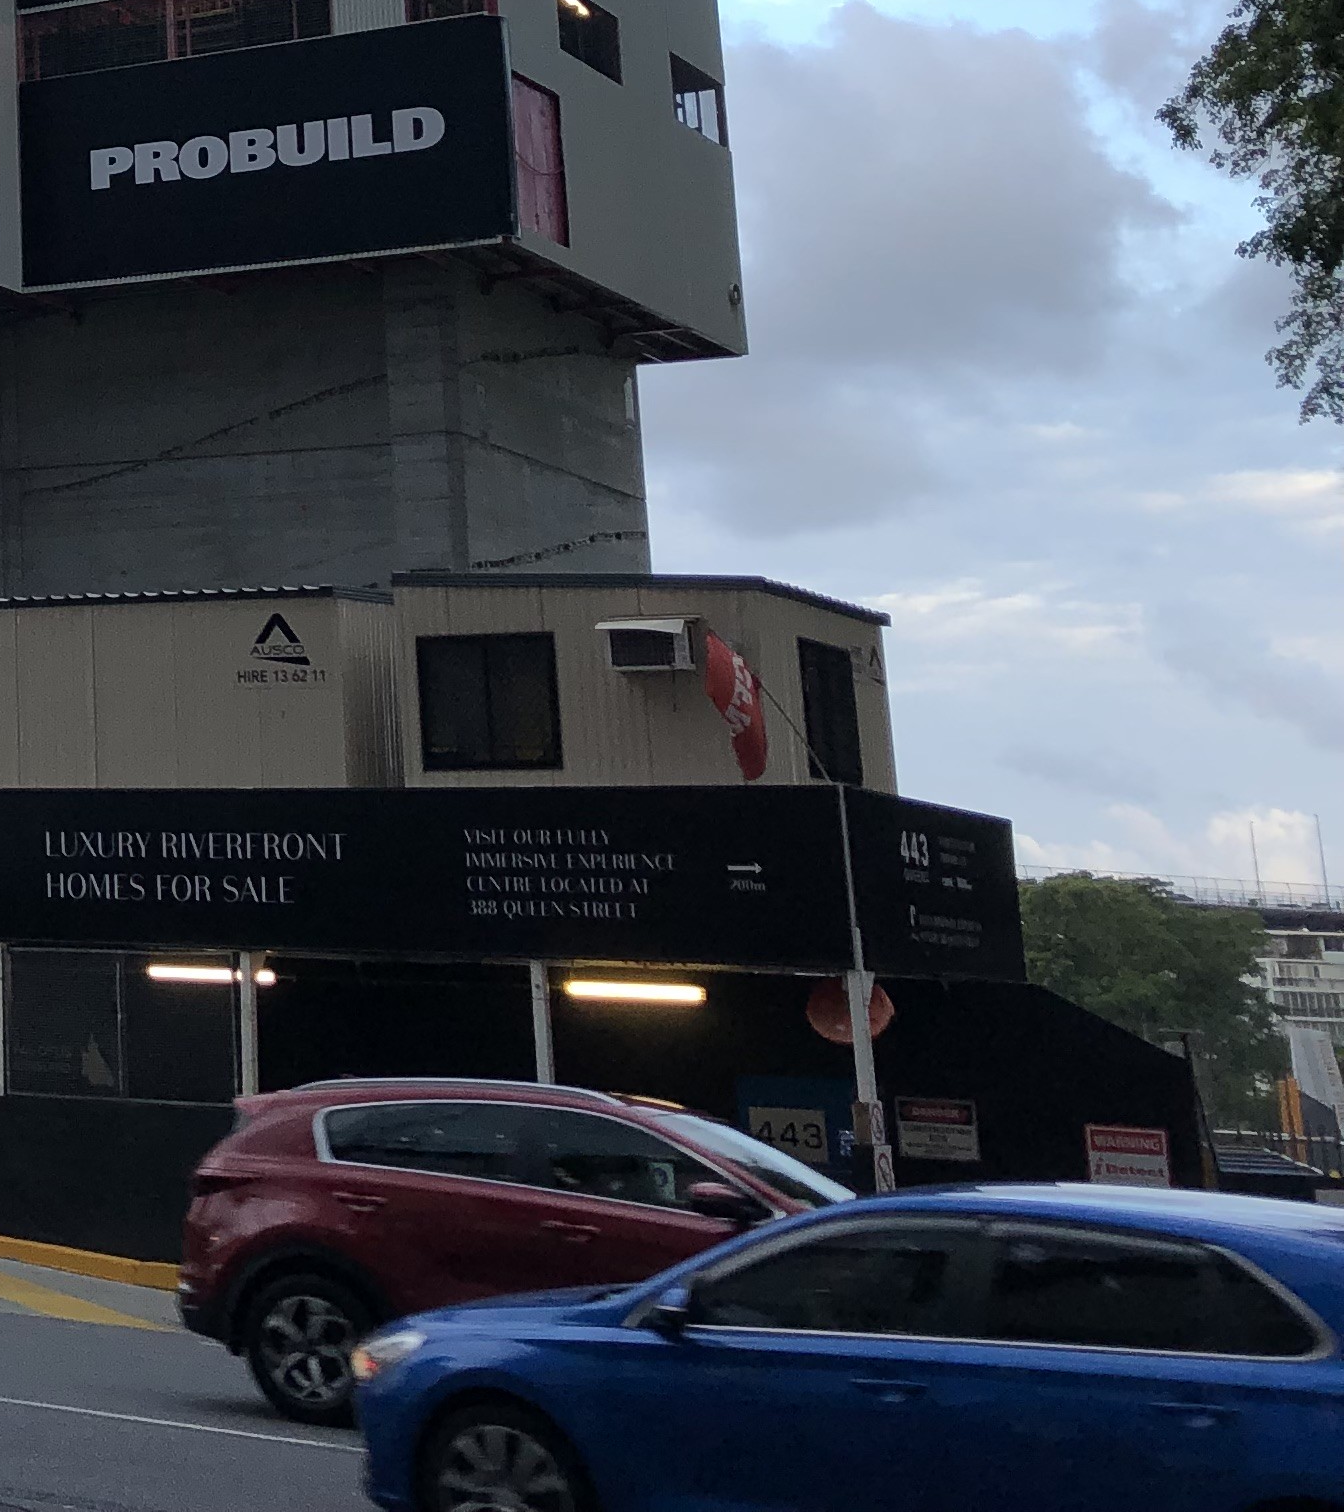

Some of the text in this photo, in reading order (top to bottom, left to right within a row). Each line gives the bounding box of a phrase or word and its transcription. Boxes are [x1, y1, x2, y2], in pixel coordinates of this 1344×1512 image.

[90, 107, 445, 190] PROBUILD
[250, 644, 305, 656] AUSCO
[237, 669, 326, 683] HIRE 13 62 11
[45, 831, 348, 860] LUXURY RIVERFRONT
[463, 829, 507, 845] VISIT
[513, 829, 551, 845] OUR
[900, 830, 929, 867] 443
[465, 852, 677, 871] IMMERSIVE EXPERIENCE
[46, 872, 295, 903] HOMES FOR SALE
[466, 875, 650, 895] CENTRE LOCATED AT
[468, 899, 639, 920] 388 QUEEN STREET
[757, 1120, 823, 1149] 443
[1094, 1134, 1160, 1151] WARNING
